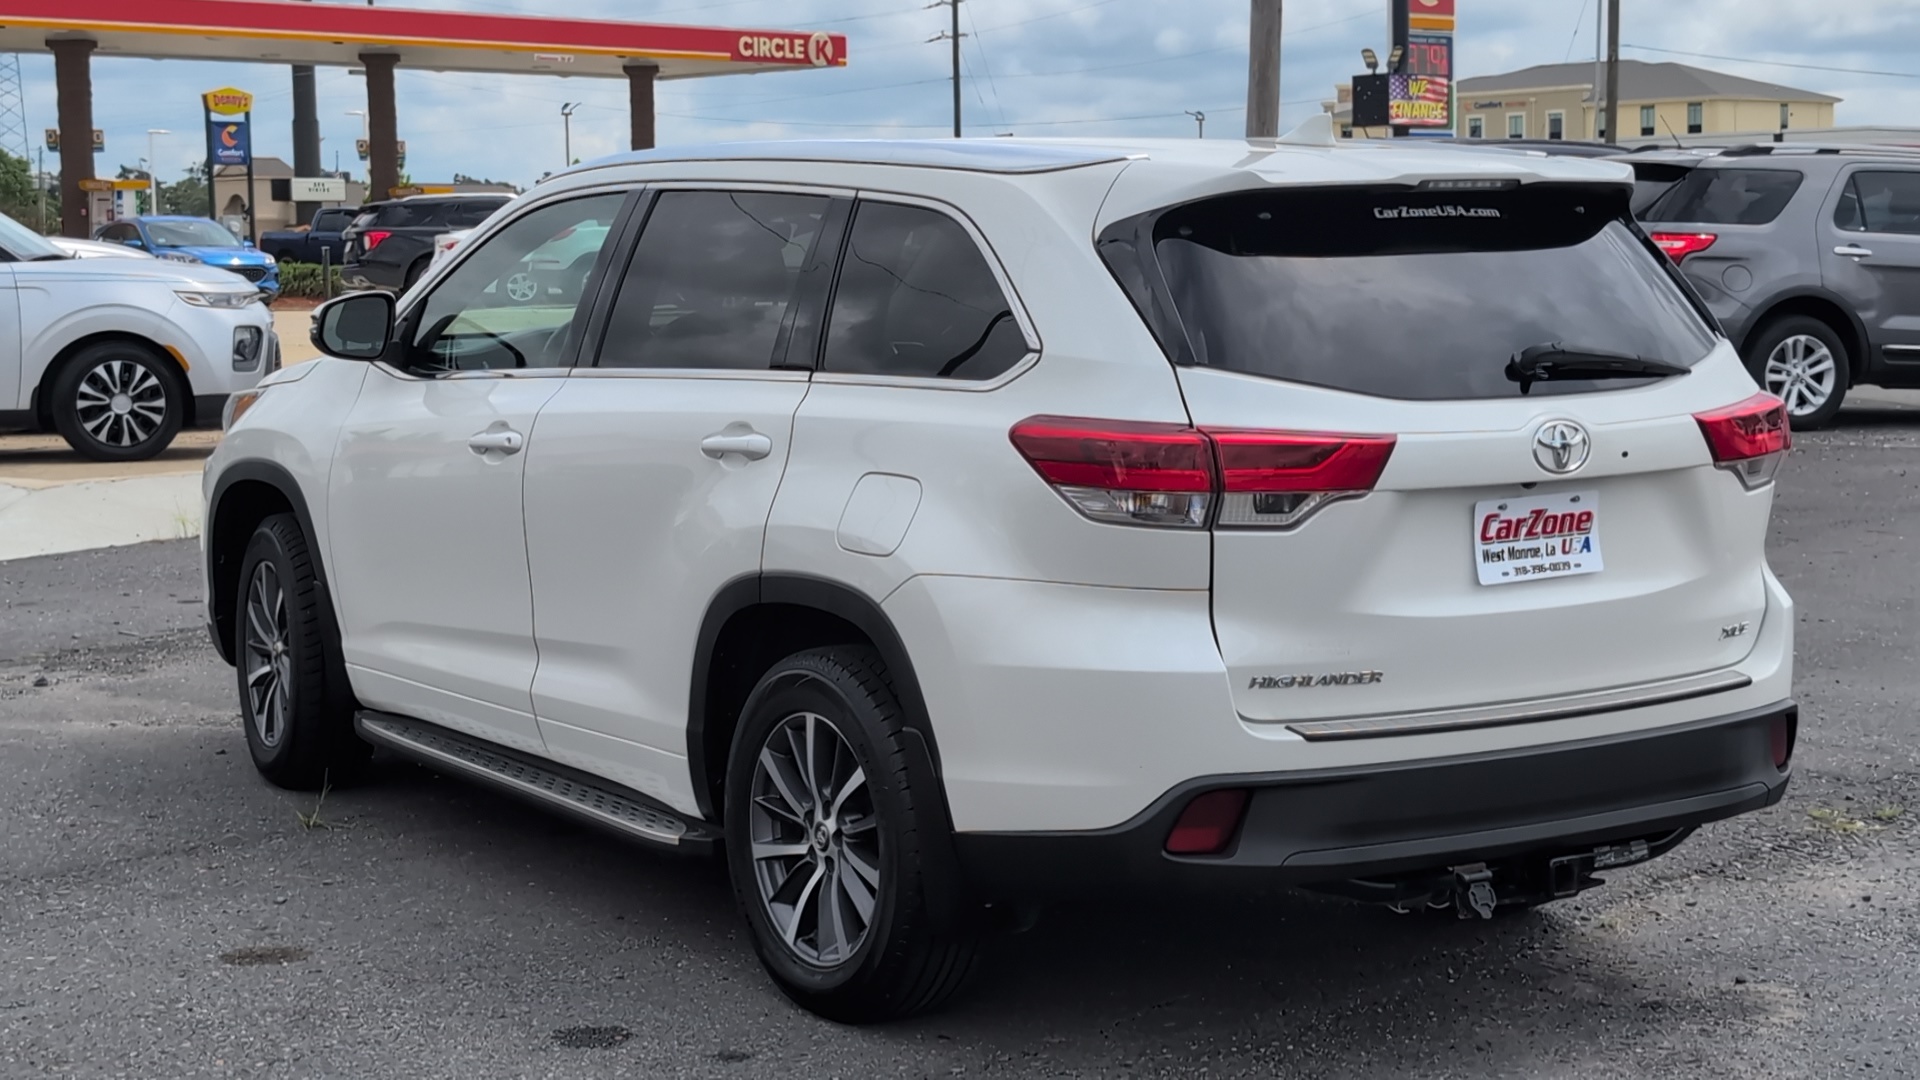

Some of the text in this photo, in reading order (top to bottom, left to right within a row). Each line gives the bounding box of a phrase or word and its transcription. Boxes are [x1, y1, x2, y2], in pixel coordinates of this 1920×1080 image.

[738, 35, 805, 59] CIRCLE
[1408, 80, 1428, 97] WE
[213, 94, 249, 109] Denny's
[1392, 102, 1444, 119] FINANCE
[1373, 205, 1501, 219] CarZoneUSA.com
[1480, 508, 1594, 545] CarZone
[1482, 542, 1556, 564] West Monroe, La
[1513, 561, 1571, 577] 318-396-0039
[1718, 621, 1750, 641] XLE
[1248, 669, 1384, 690] HIGHLANDER
